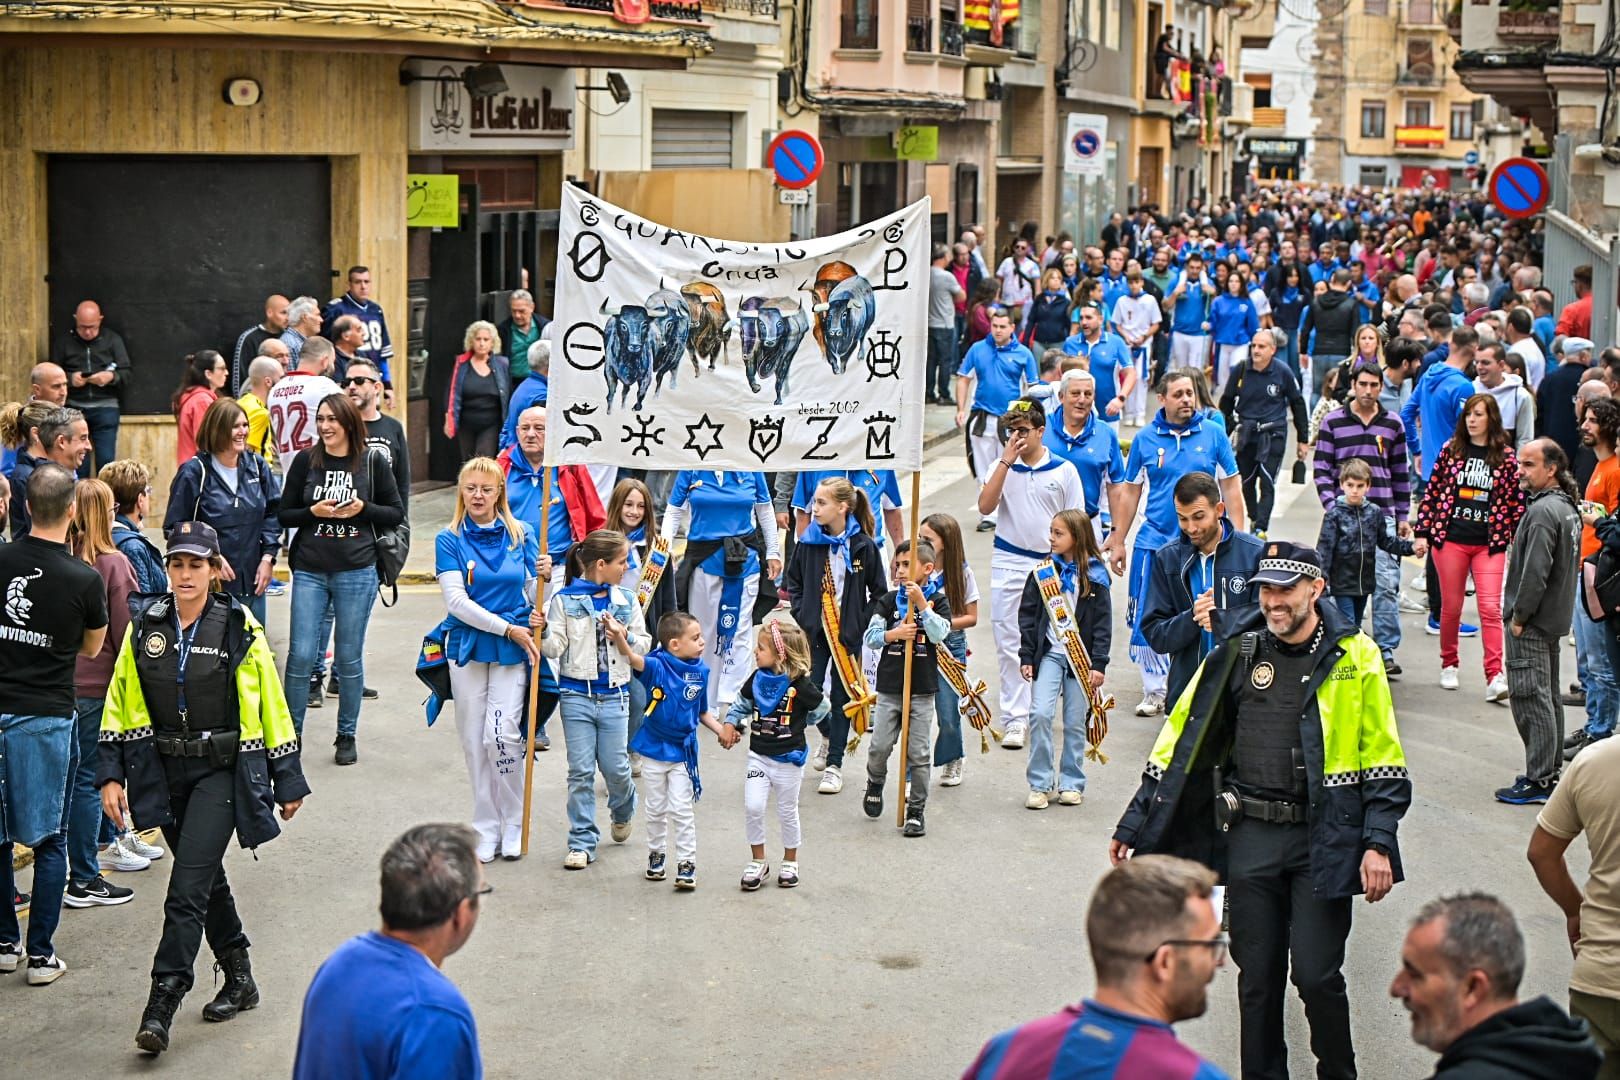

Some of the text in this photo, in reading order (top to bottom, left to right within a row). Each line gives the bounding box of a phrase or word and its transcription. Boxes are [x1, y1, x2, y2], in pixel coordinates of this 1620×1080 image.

[799, 402, 825, 415] desde
[1464, 457, 1491, 476] FIRA
[324, 470, 354, 488] FIRA
[0, 624, 54, 648] NVIRODES
[190, 646, 219, 656] OLICIA
[1331, 673, 1355, 681] LOCAL
